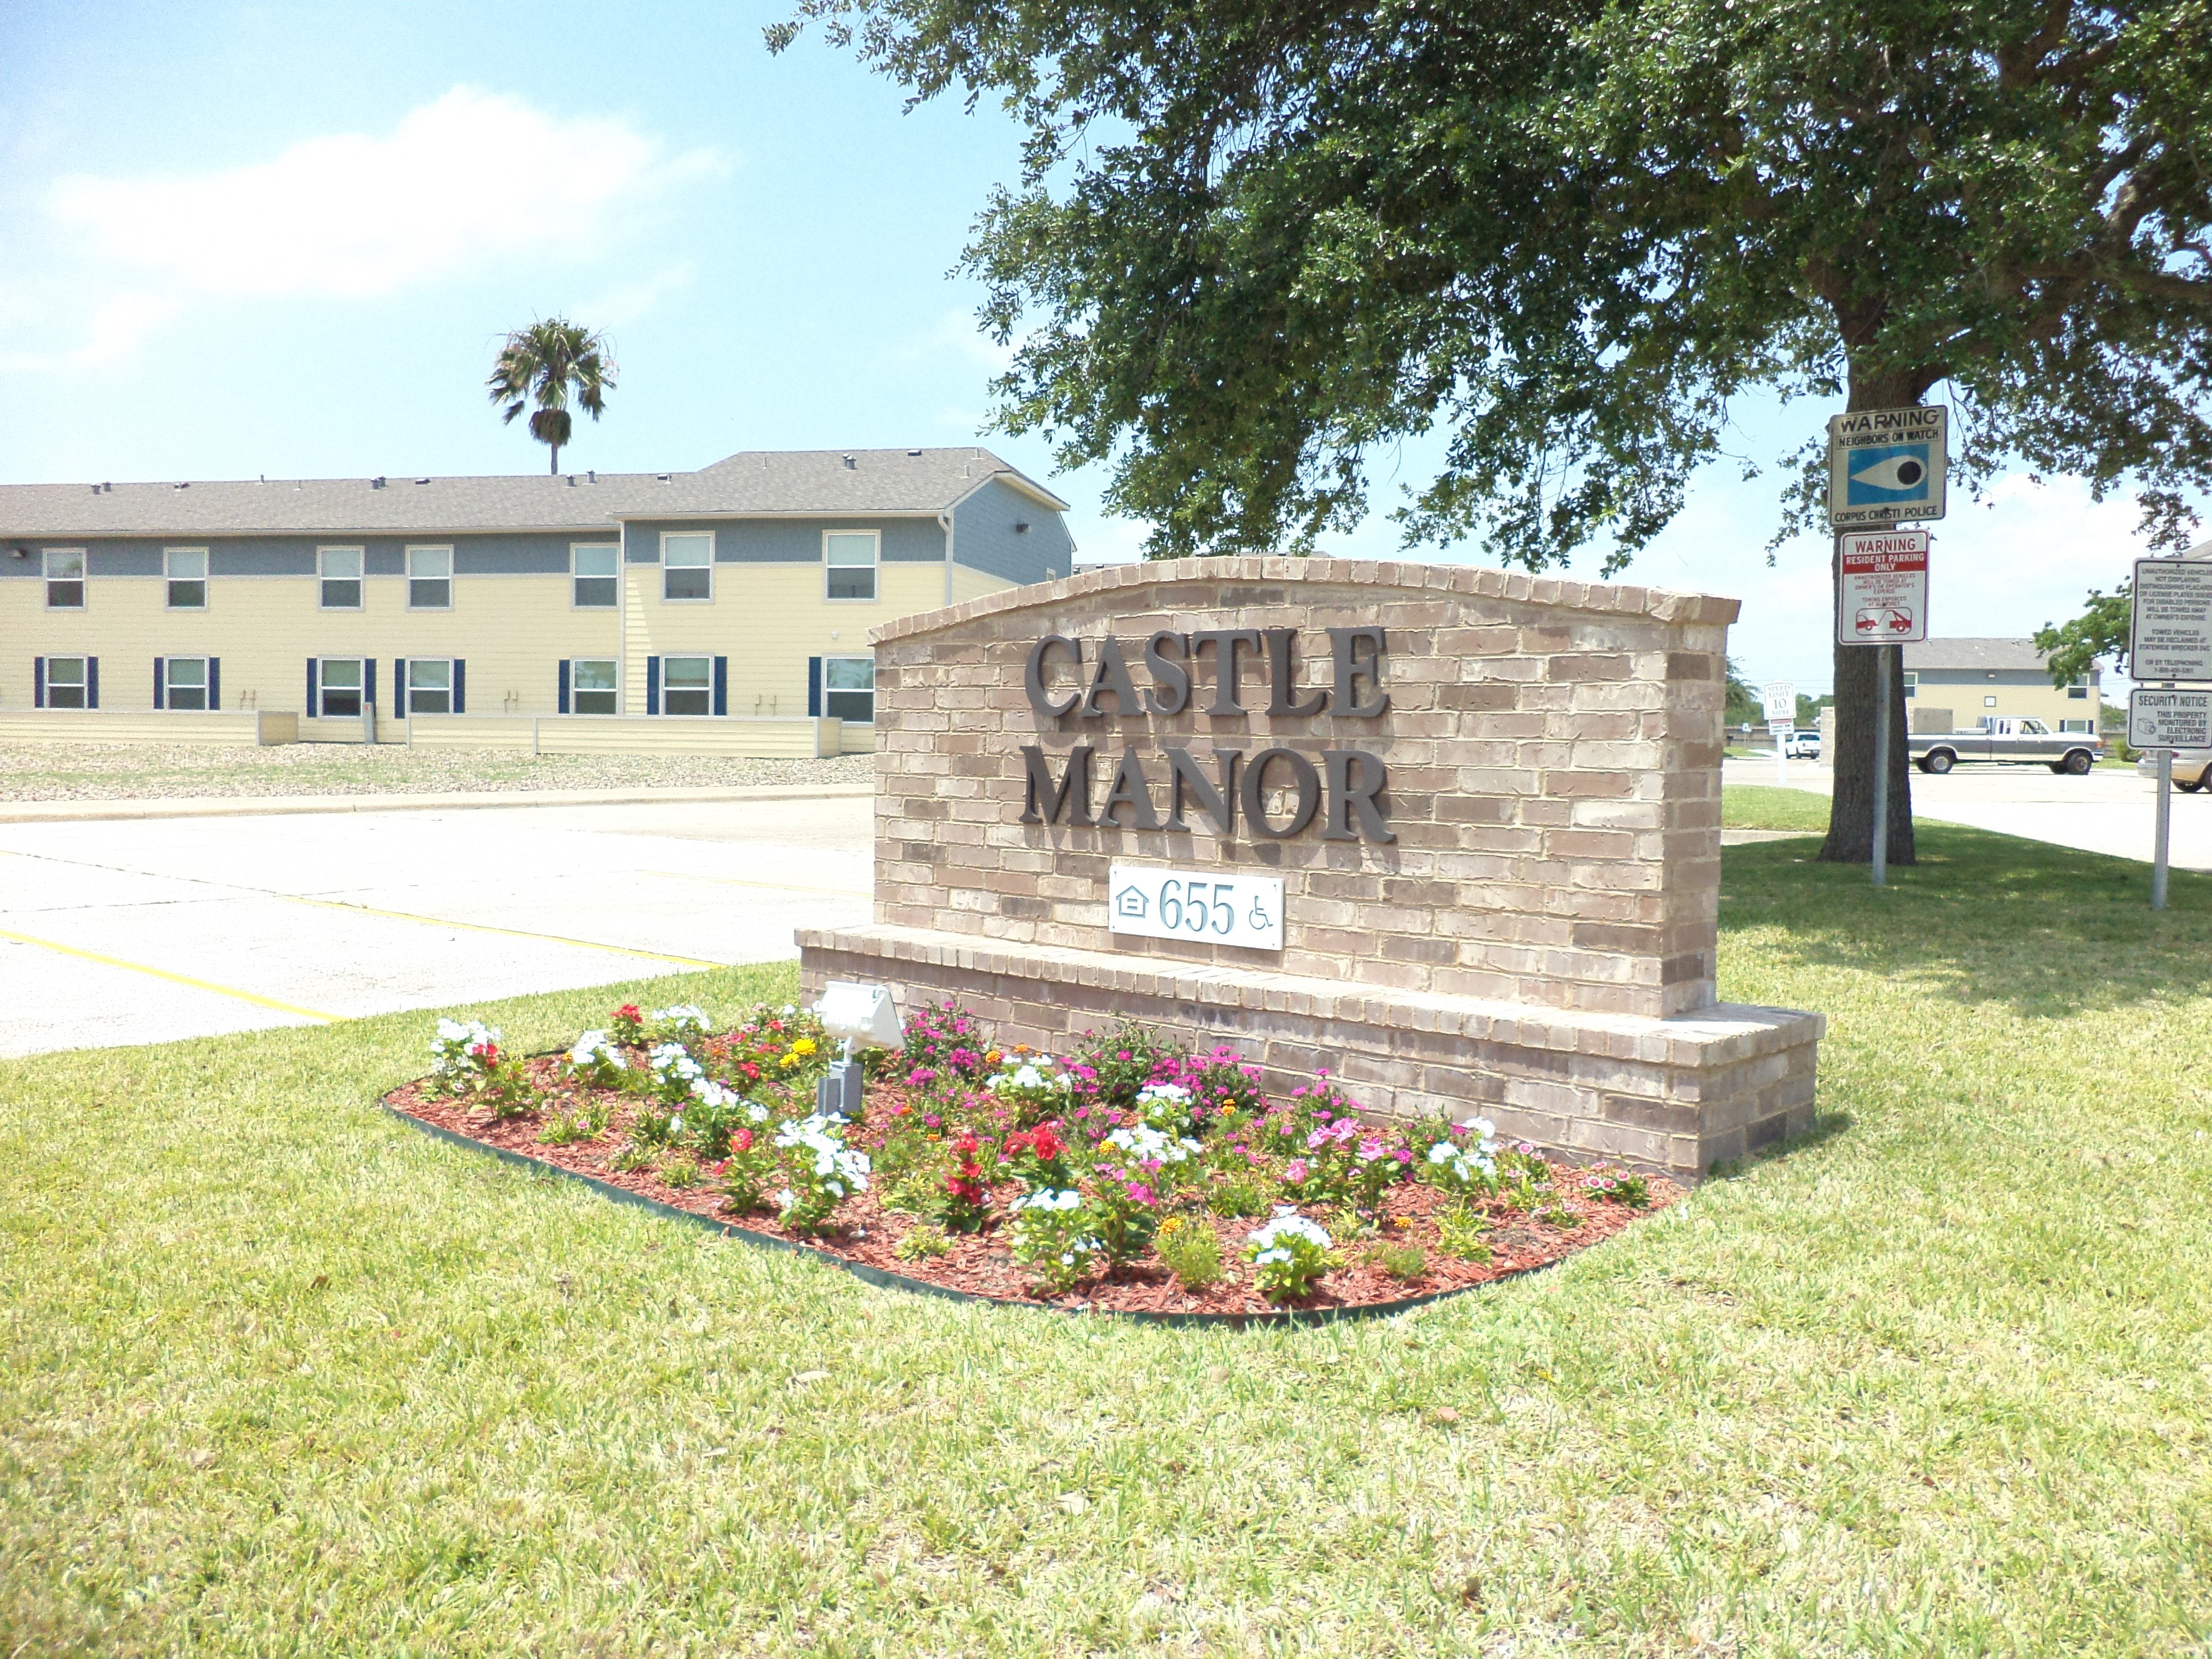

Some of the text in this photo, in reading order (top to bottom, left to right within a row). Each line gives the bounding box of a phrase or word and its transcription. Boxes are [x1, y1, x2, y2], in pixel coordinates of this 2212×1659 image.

[1841, 410, 1939, 432] WARNING
[1839, 429, 1939, 446] NEIGHBORS ON WATCH
[1835, 506, 1937, 522] CORPUS CHRISTI POLICE
[1856, 538, 1916, 552] WARNING
[1846, 554, 1924, 564] RESIDENT PARKING
[1875, 563, 1895, 571] ONLY
[1024, 626, 1391, 718] CASTLE
[1774, 698, 1786, 709] 10
[2138, 695, 2207, 707] SECURITY NOTICE
[1018, 745, 1397, 844] MANOR
[1159, 879, 1235, 934] 655
